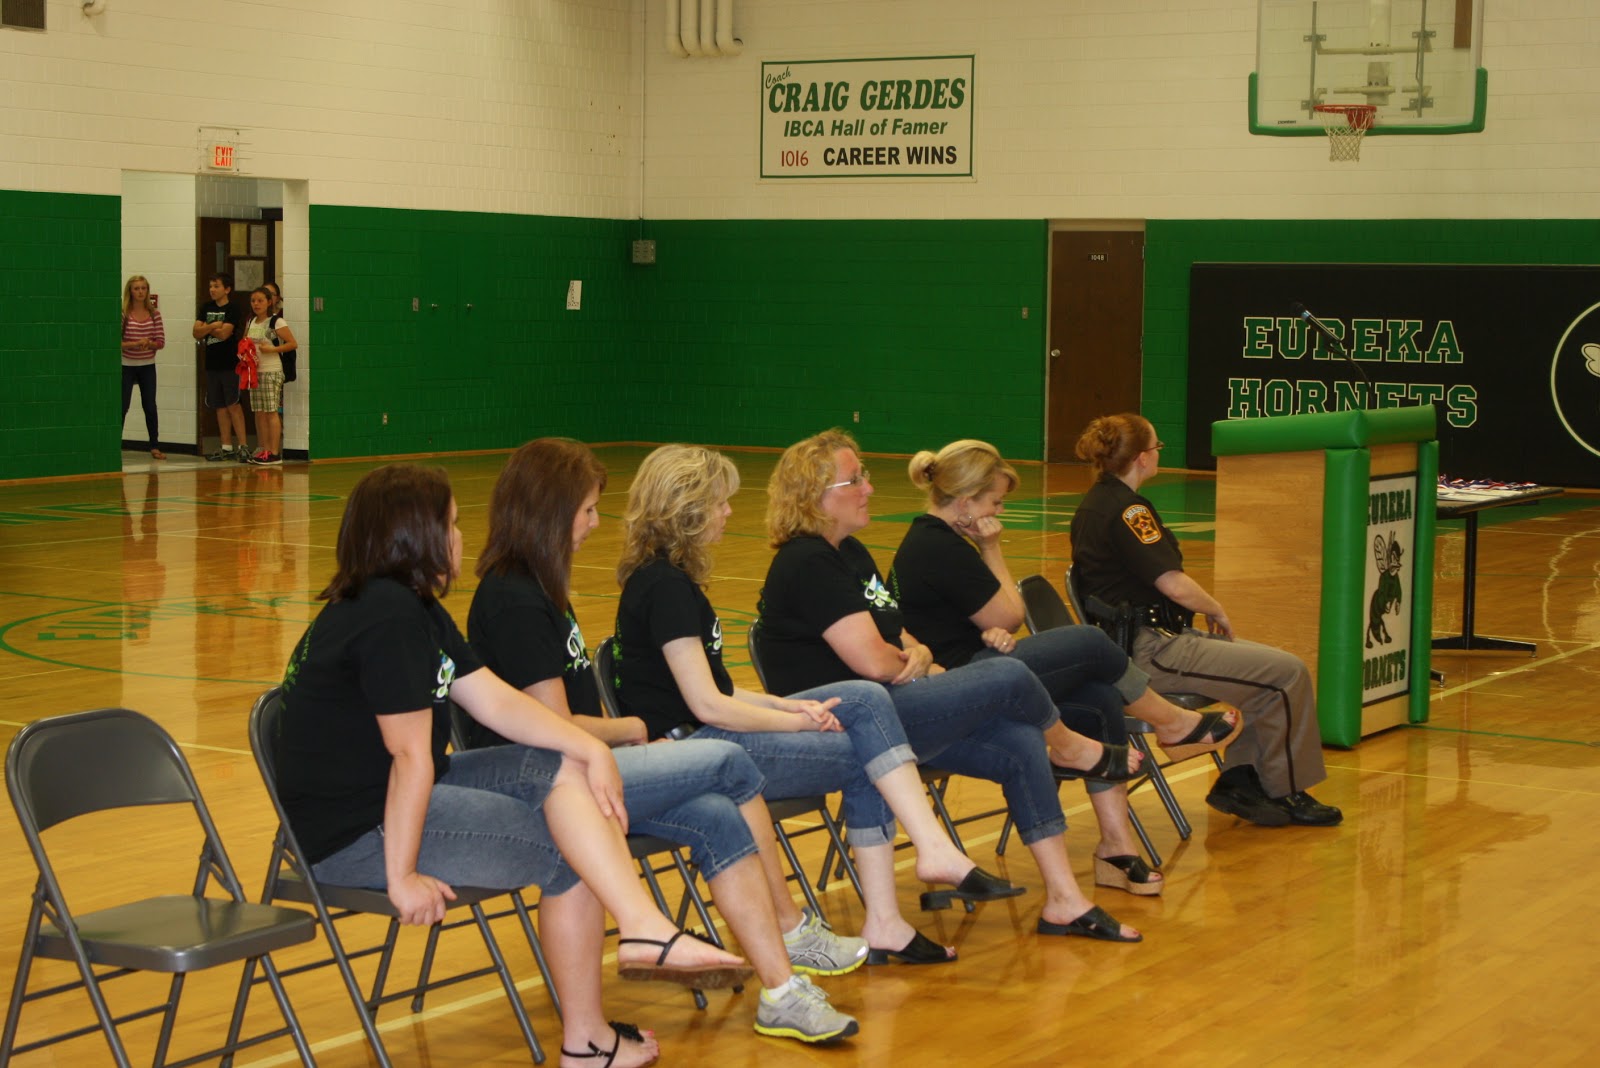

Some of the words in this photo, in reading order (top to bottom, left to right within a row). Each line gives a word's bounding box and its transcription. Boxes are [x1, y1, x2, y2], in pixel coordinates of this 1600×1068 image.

[765, 66, 791, 89] Coach
[768, 81, 850, 113] CRAIG
[860, 78, 966, 111] GERDES
[783, 120, 825, 137] IBCA
[830, 119, 866, 136] Hall
[869, 118, 889, 136] of
[891, 118, 949, 135] Famer
[215, 146, 234, 167] EXIT
[780, 150, 809, 167] 1016
[823, 147, 900, 166] CAREER
[906, 145, 957, 165] WINS
[1243, 316, 1464, 364] EUREKA
[1227, 377, 1478, 428] HORNETS
[1363, 648, 1406, 691] ORNETS
